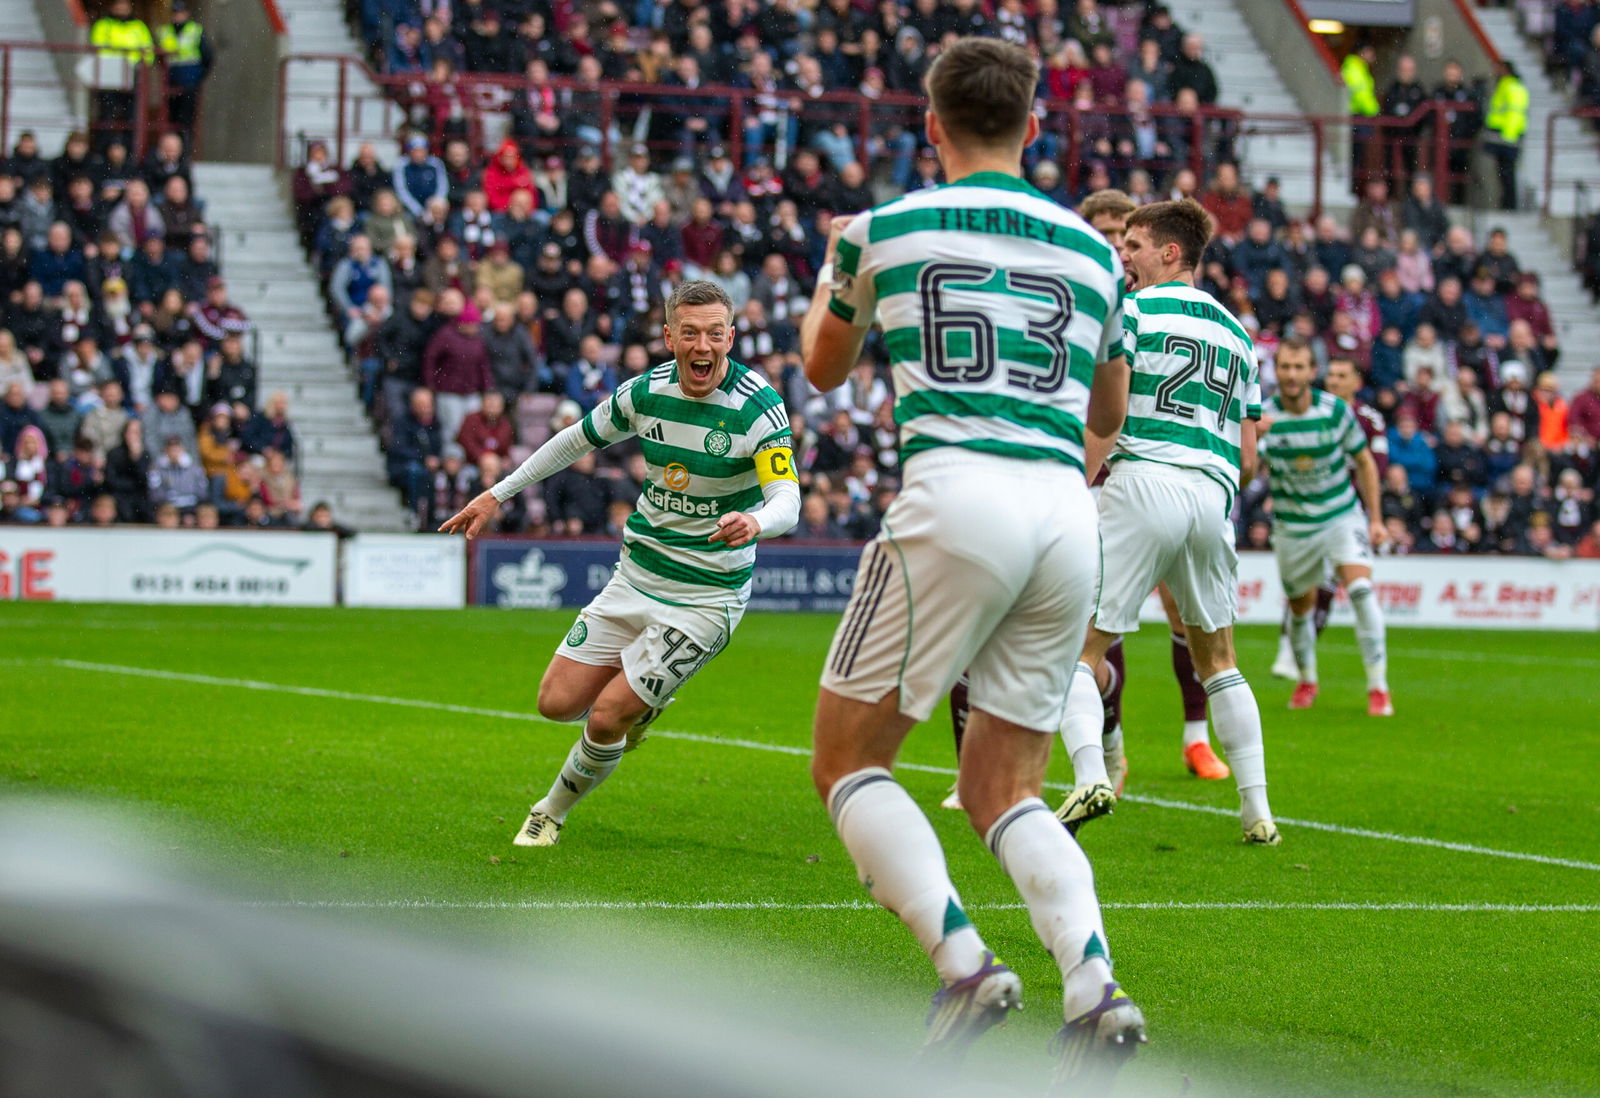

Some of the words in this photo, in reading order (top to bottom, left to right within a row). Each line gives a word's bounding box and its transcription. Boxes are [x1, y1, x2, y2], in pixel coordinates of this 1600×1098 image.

[935, 207, 1058, 243] TIERNEY
[919, 262, 1074, 393] 63
[1155, 335, 1241, 431] 24
[770, 452, 788, 475] C
[647, 485, 719, 516] dafabet
[751, 567, 812, 594] OTEL
[813, 568, 836, 595] &
[661, 627, 703, 679] 42
